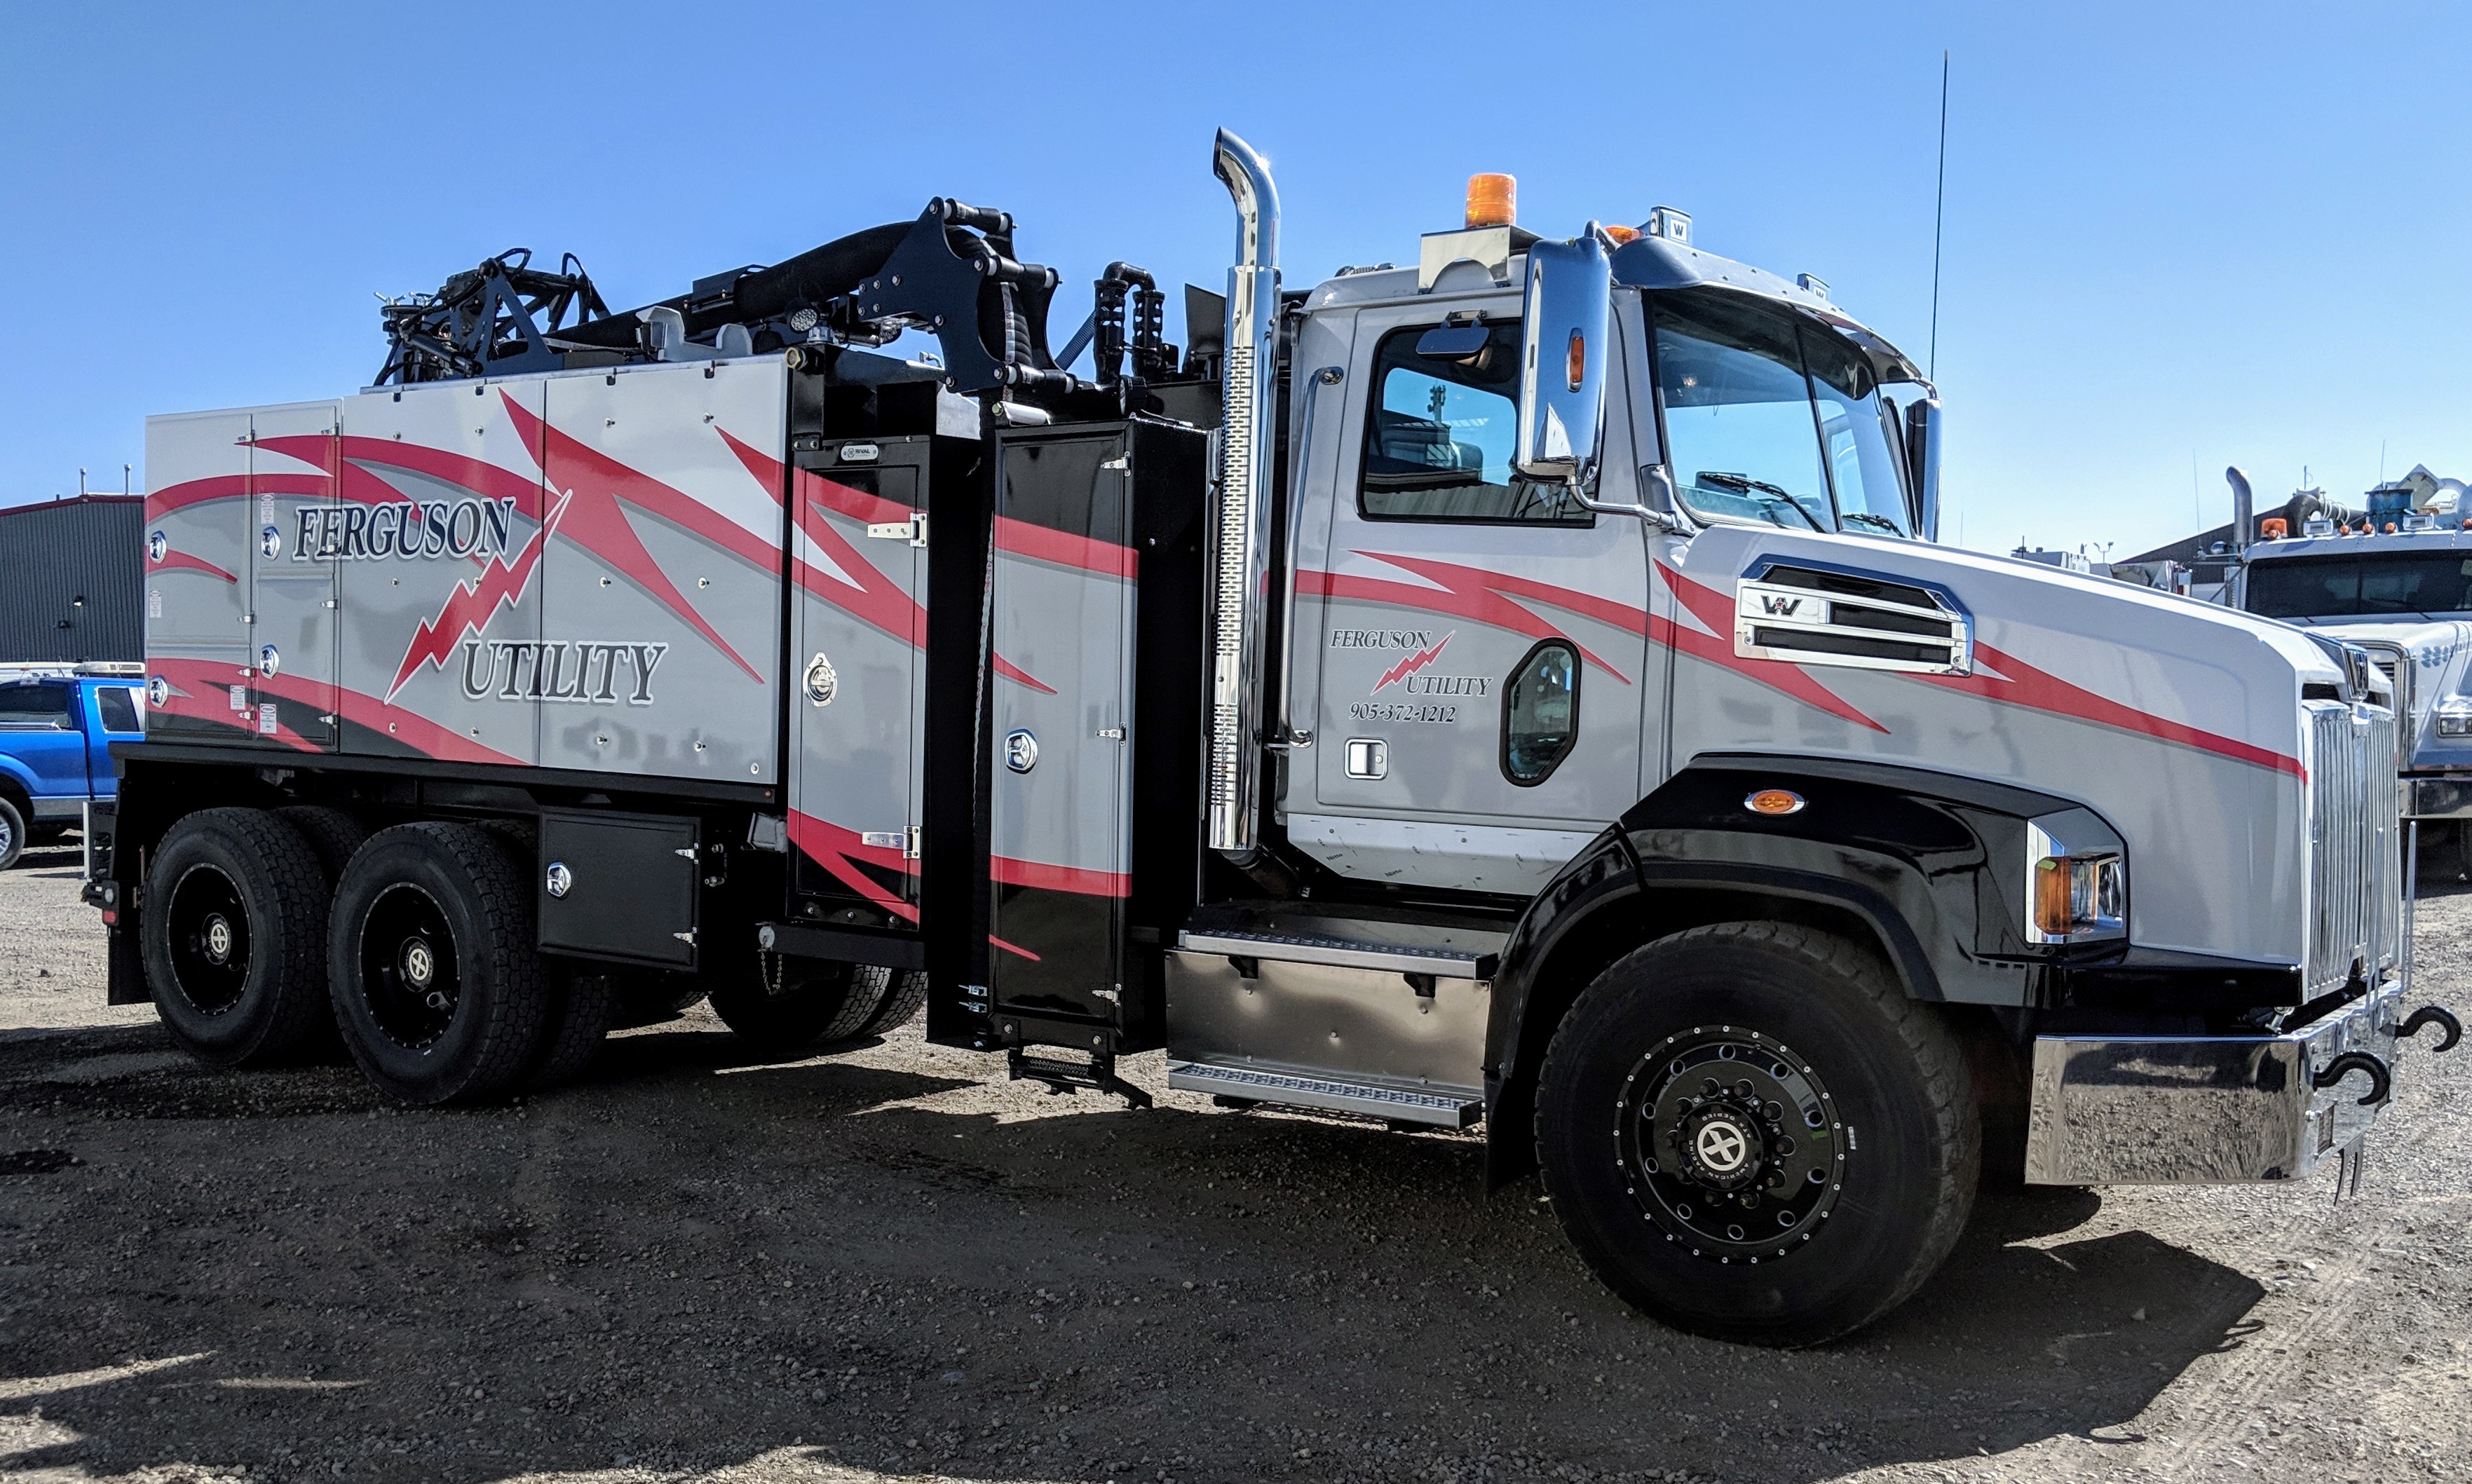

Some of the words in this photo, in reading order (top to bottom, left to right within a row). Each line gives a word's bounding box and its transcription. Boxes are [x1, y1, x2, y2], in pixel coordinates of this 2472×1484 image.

[1673, 222, 1684, 236] W
[293, 496, 516, 560] FERGUSON
[1760, 594, 1803, 617] W
[1330, 629, 1431, 649] FERGUSON
[463, 639, 669, 704] UTILITY
[1406, 676, 1493, 696] UTILITY
[1349, 702, 1457, 723] 905-372-1212
[1326, 852, 1343, 862] Nitto
[1384, 868, 1403, 877] Nitto
[1702, 1112, 1735, 1121] SERIES
[1739, 1122, 1751, 1138] ATX
[1688, 1140, 1705, 1171] RACING
[1708, 1162, 1749, 1180] AMERICAN
